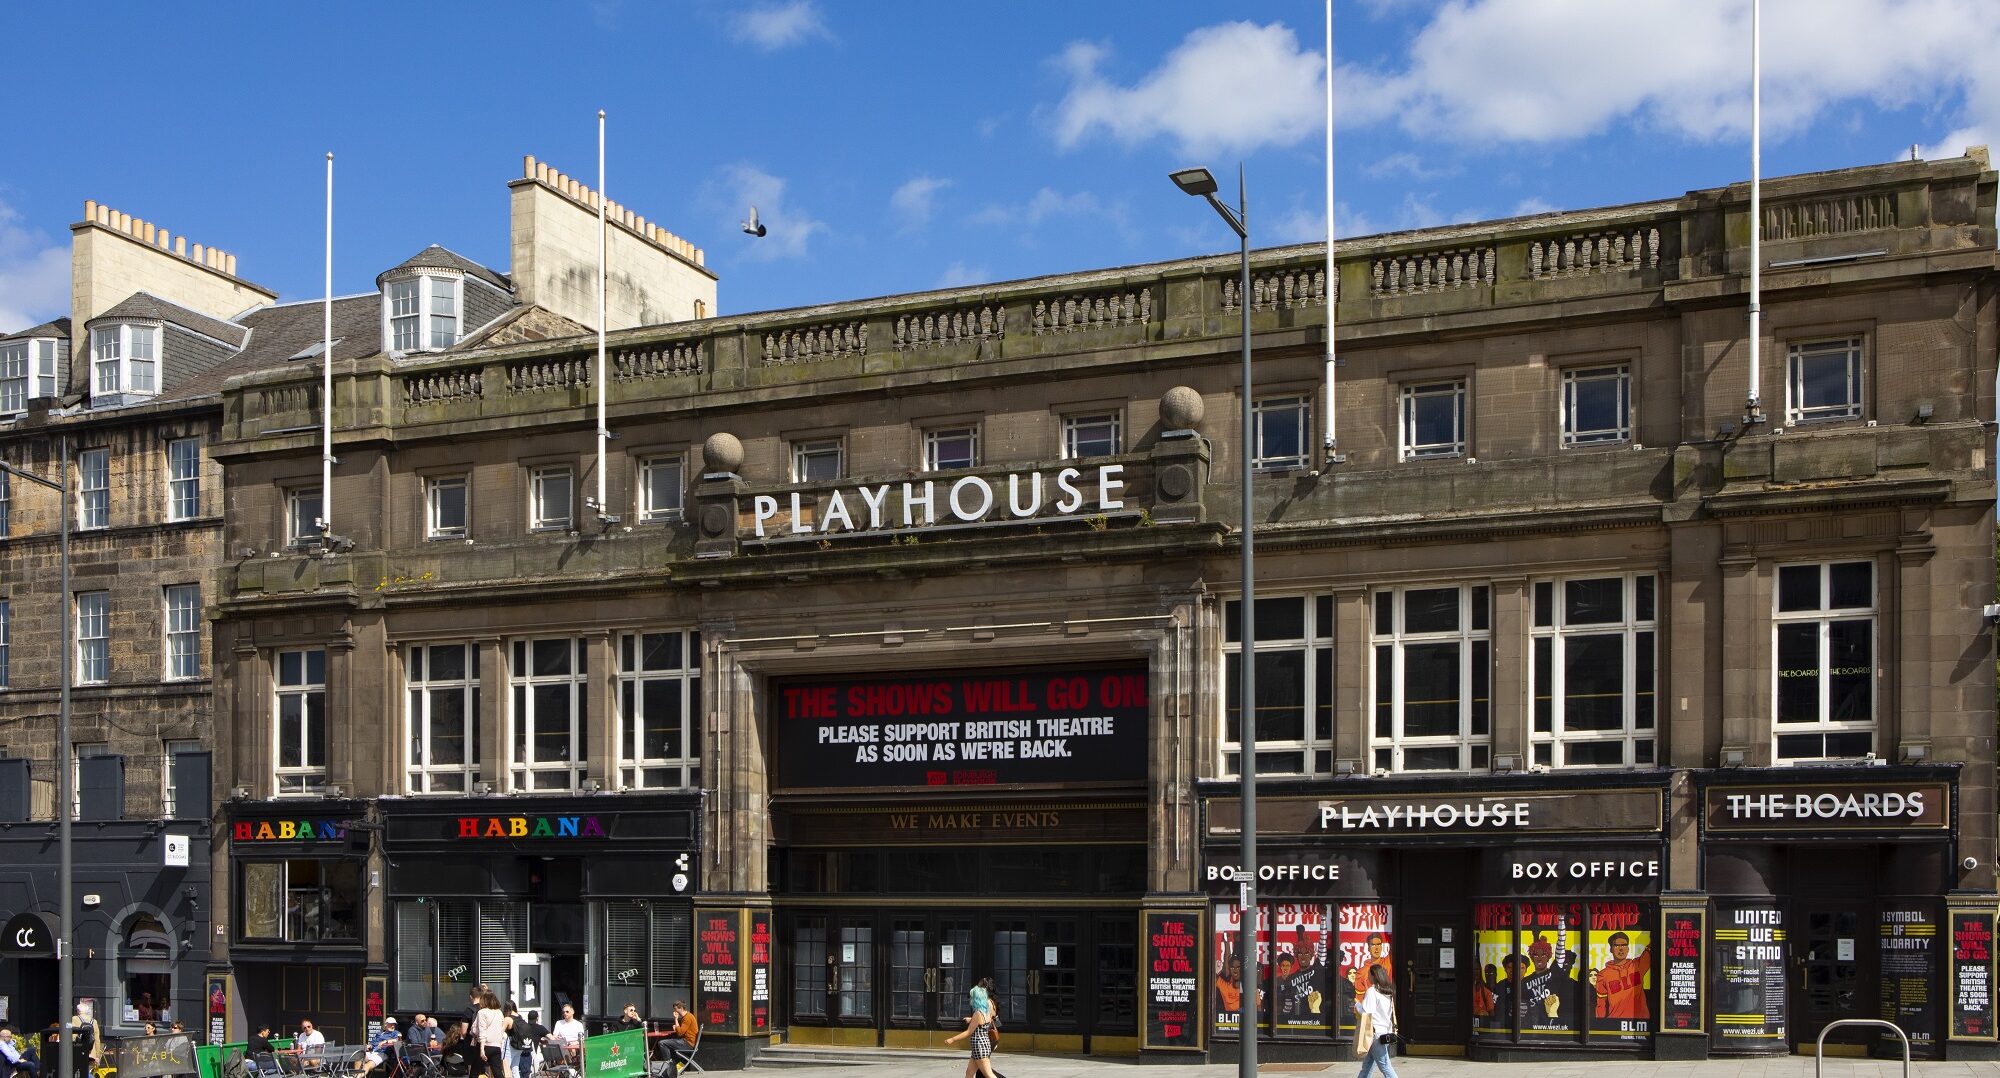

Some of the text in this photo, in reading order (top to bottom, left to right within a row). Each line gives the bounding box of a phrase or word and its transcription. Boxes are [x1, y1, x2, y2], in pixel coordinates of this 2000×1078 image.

[754, 465, 1124, 537] PLAYHOUSE
[1778, 669, 1819, 678] THE BOARDS
[1842, 667, 1871, 675] BOARDS
[784, 688, 837, 719] THE
[847, 682, 953, 717] SHOWS
[963, 679, 1037, 713] WILL
[1047, 677, 1088, 710] GO
[818, 716, 1114, 744] PLEASE SUPPORT BRITISH THEATRE
[856, 739, 1072, 763] AS SOON AS WE'RE BACK.
[1727, 791, 1924, 818] THE BOARDS
[891, 812, 1060, 828] WE MAKE EVENTS
[1321, 803, 1529, 829] PLAYHOUSE
[458, 816, 605, 838] HABANA
[1207, 865, 1339, 880] BO OFFICE
[1512, 861, 1658, 879] BOX OFFICE
[1735, 910, 1782, 924] UNITED
[1886, 911, 1926, 922] SYMBOL
[709, 919, 728, 930] THE
[1162, 921, 1184, 934] THE
[1675, 921, 1692, 929] THE
[1893, 925, 1904, 935] OF
[1963, 922, 1983, 931] THE
[16, 927, 36, 947] CC
[701, 930, 736, 942] SHOWS
[1667, 930, 1700, 939] SHOWS
[1750, 928, 1772, 942] WE
[1955, 931, 1991, 941] SHOWS
[1152, 935, 1194, 947] SHOWS
[1672, 939, 1695, 947] WILL
[1962, 941, 1985, 950] WILL
[707, 943, 729, 953] WILL
[1160, 948, 1187, 959] WILL
[1668, 948, 1681, 957] GO
[1736, 946, 1780, 959] STAND
[702, 953, 715, 965] GO
[1956, 950, 1970, 959] GO
[1154, 960, 1192, 972] GO ON.
[618, 968, 638, 986] open
[1621, 1020, 1648, 1032] BLM
[1723, 1027, 1765, 1035] www.wezi.uk
[1911, 1032, 1930, 1040] BLM
[600, 1058, 627, 1071] Heineken
